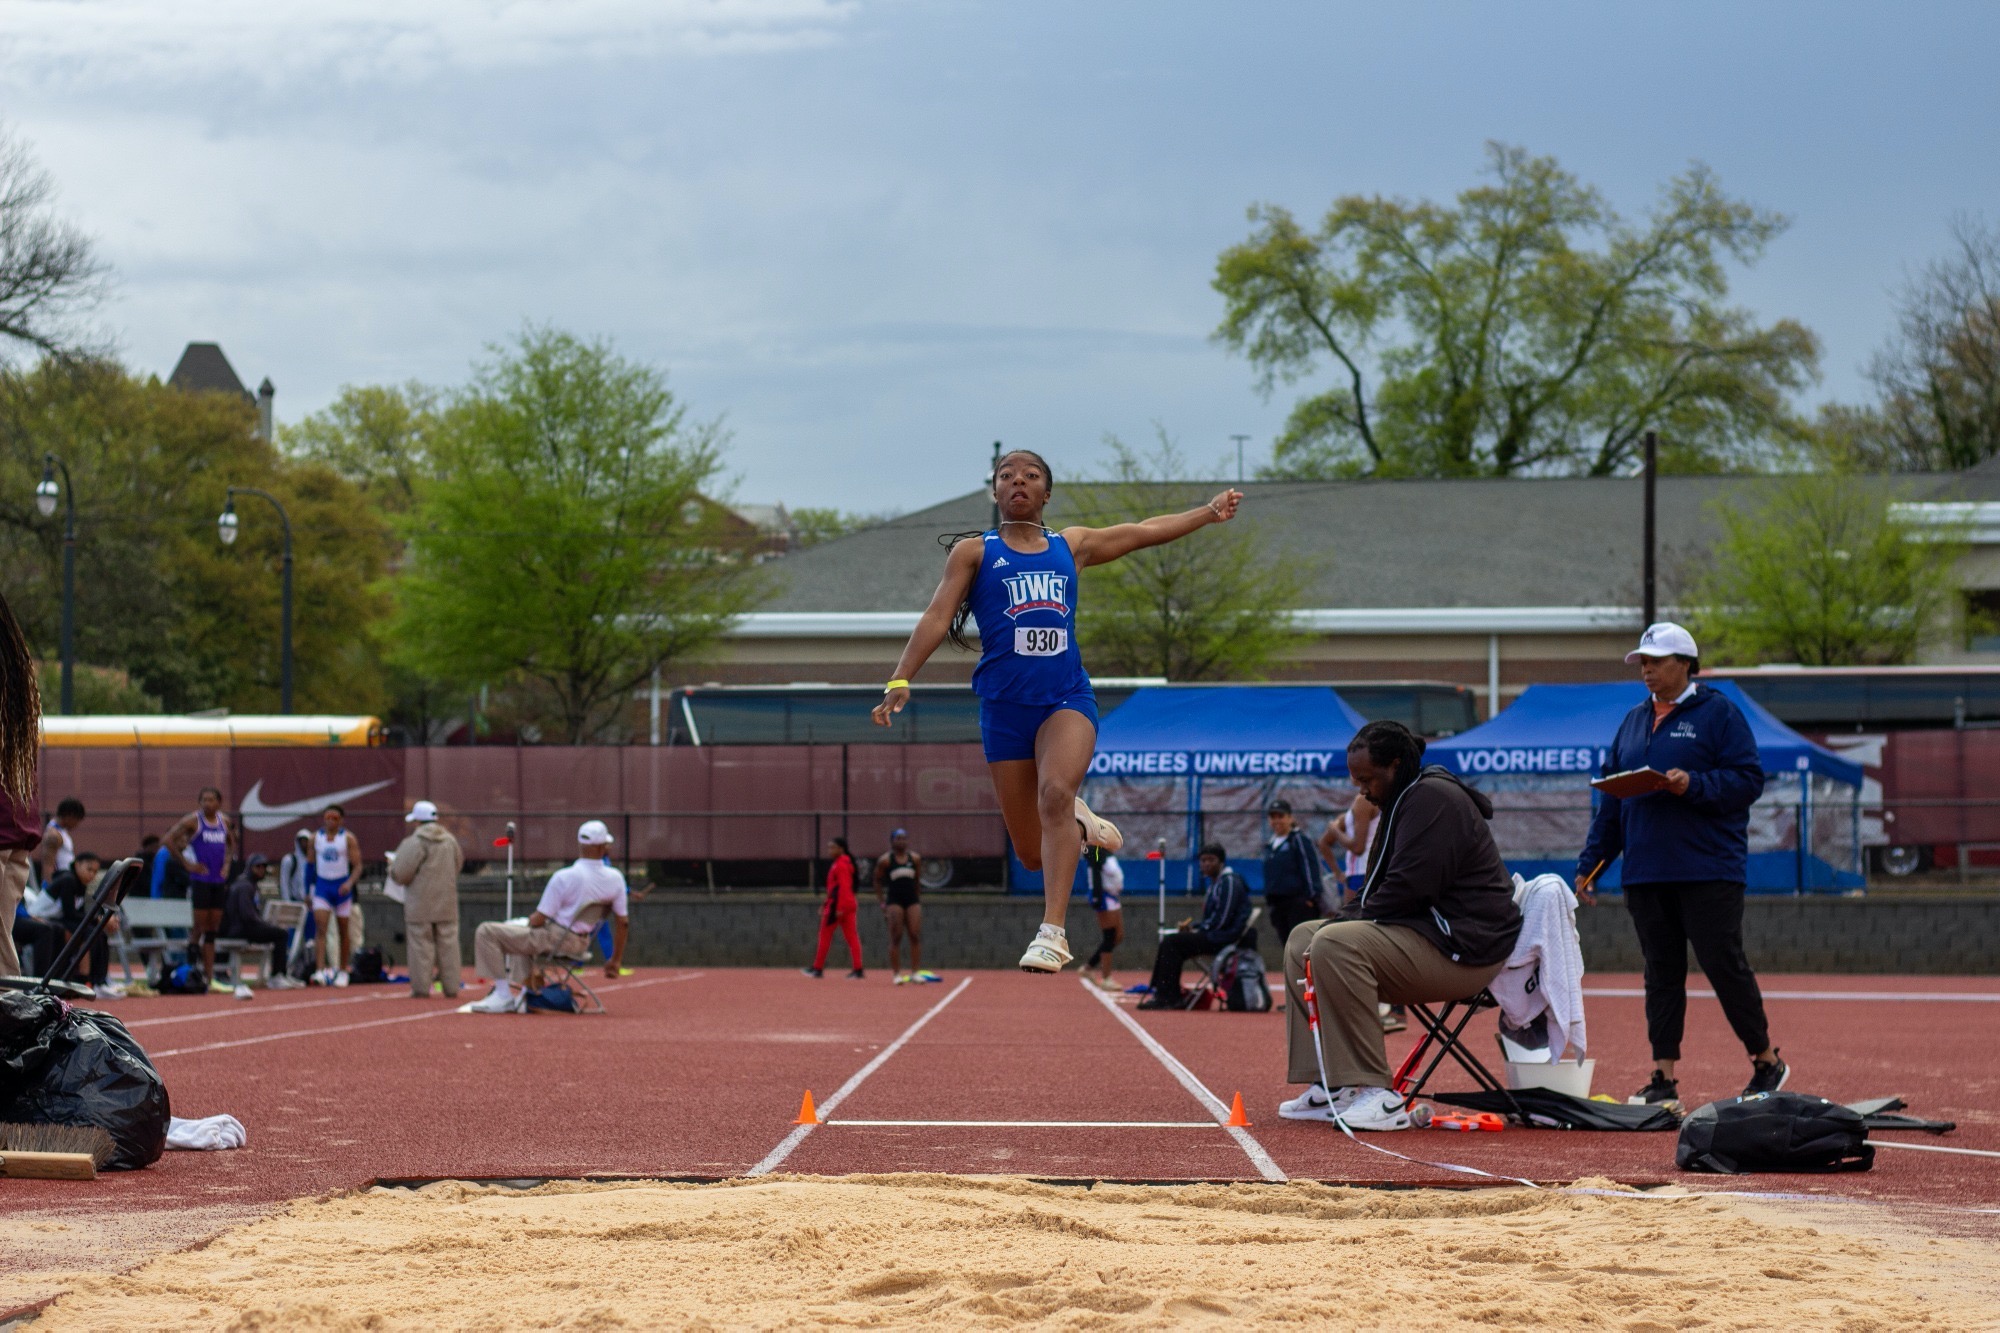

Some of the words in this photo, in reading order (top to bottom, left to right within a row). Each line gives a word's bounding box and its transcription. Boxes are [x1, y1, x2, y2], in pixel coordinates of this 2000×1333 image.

[1009, 574, 1063, 605] UWG
[1026, 629, 1059, 652] 930
[1194, 752, 1333, 773] UNIVERSITY
[1456, 750, 1593, 772] VOORHEES
